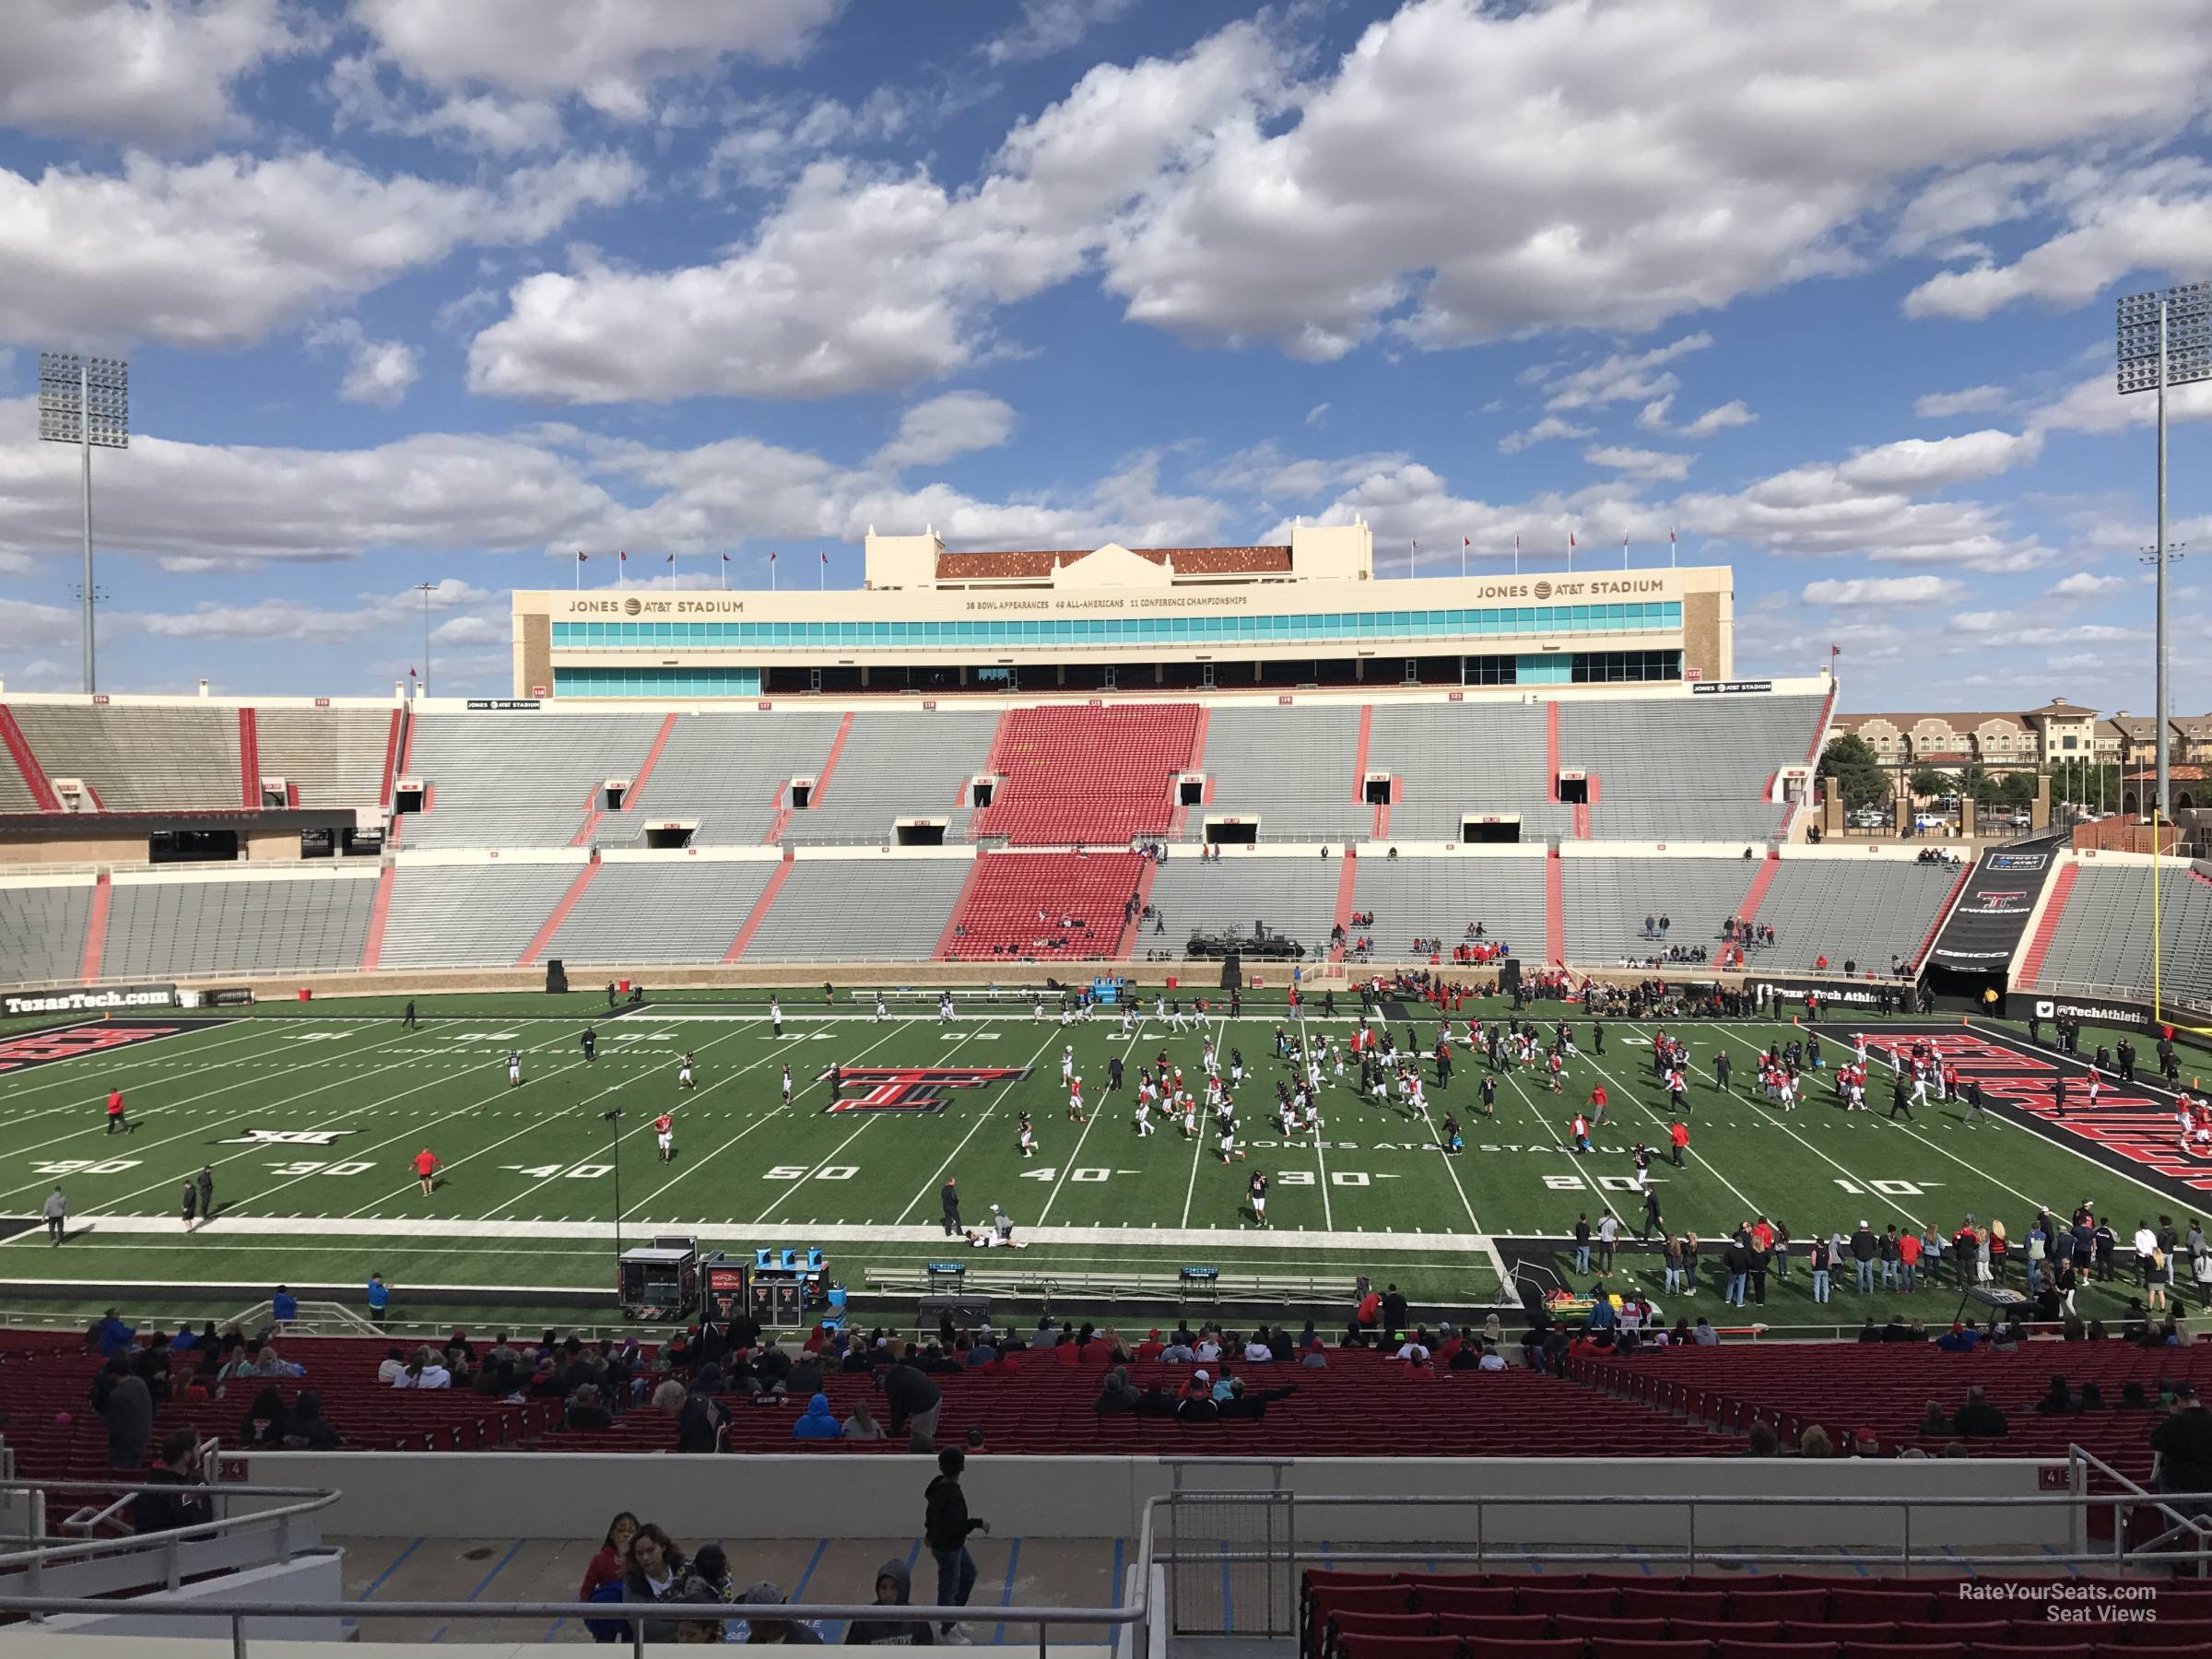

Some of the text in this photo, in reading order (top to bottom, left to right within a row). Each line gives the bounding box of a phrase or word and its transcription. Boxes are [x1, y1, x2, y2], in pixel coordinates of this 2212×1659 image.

[1477, 579, 1664, 598] JONES AT&T STADIUM
[569, 601, 744, 613] JONES AT&T STADIUM
[977, 601, 998, 610] BOWL
[999, 600, 1049, 610] APPEARANCES
[1066, 599, 1124, 609] ALL-AMERICANS
[1130, 595, 1247, 607] 11 CONFERENCE CHAMPIONSHIPS
[1936, 949, 2009, 958] GEICO
[6, 991, 169, 1013] TexasTech.com
[2057, 1006, 2148, 1025] @TechAthletics
[271, 1161, 378, 1175] 30
[519, 1164, 616, 1178] 40
[762, 1166, 861, 1180] 50
[1019, 1167, 1112, 1182] 40
[1277, 1170, 1371, 1186] 30
[1542, 1175, 1644, 1191] 20
[1832, 1179, 1924, 1195] 10
